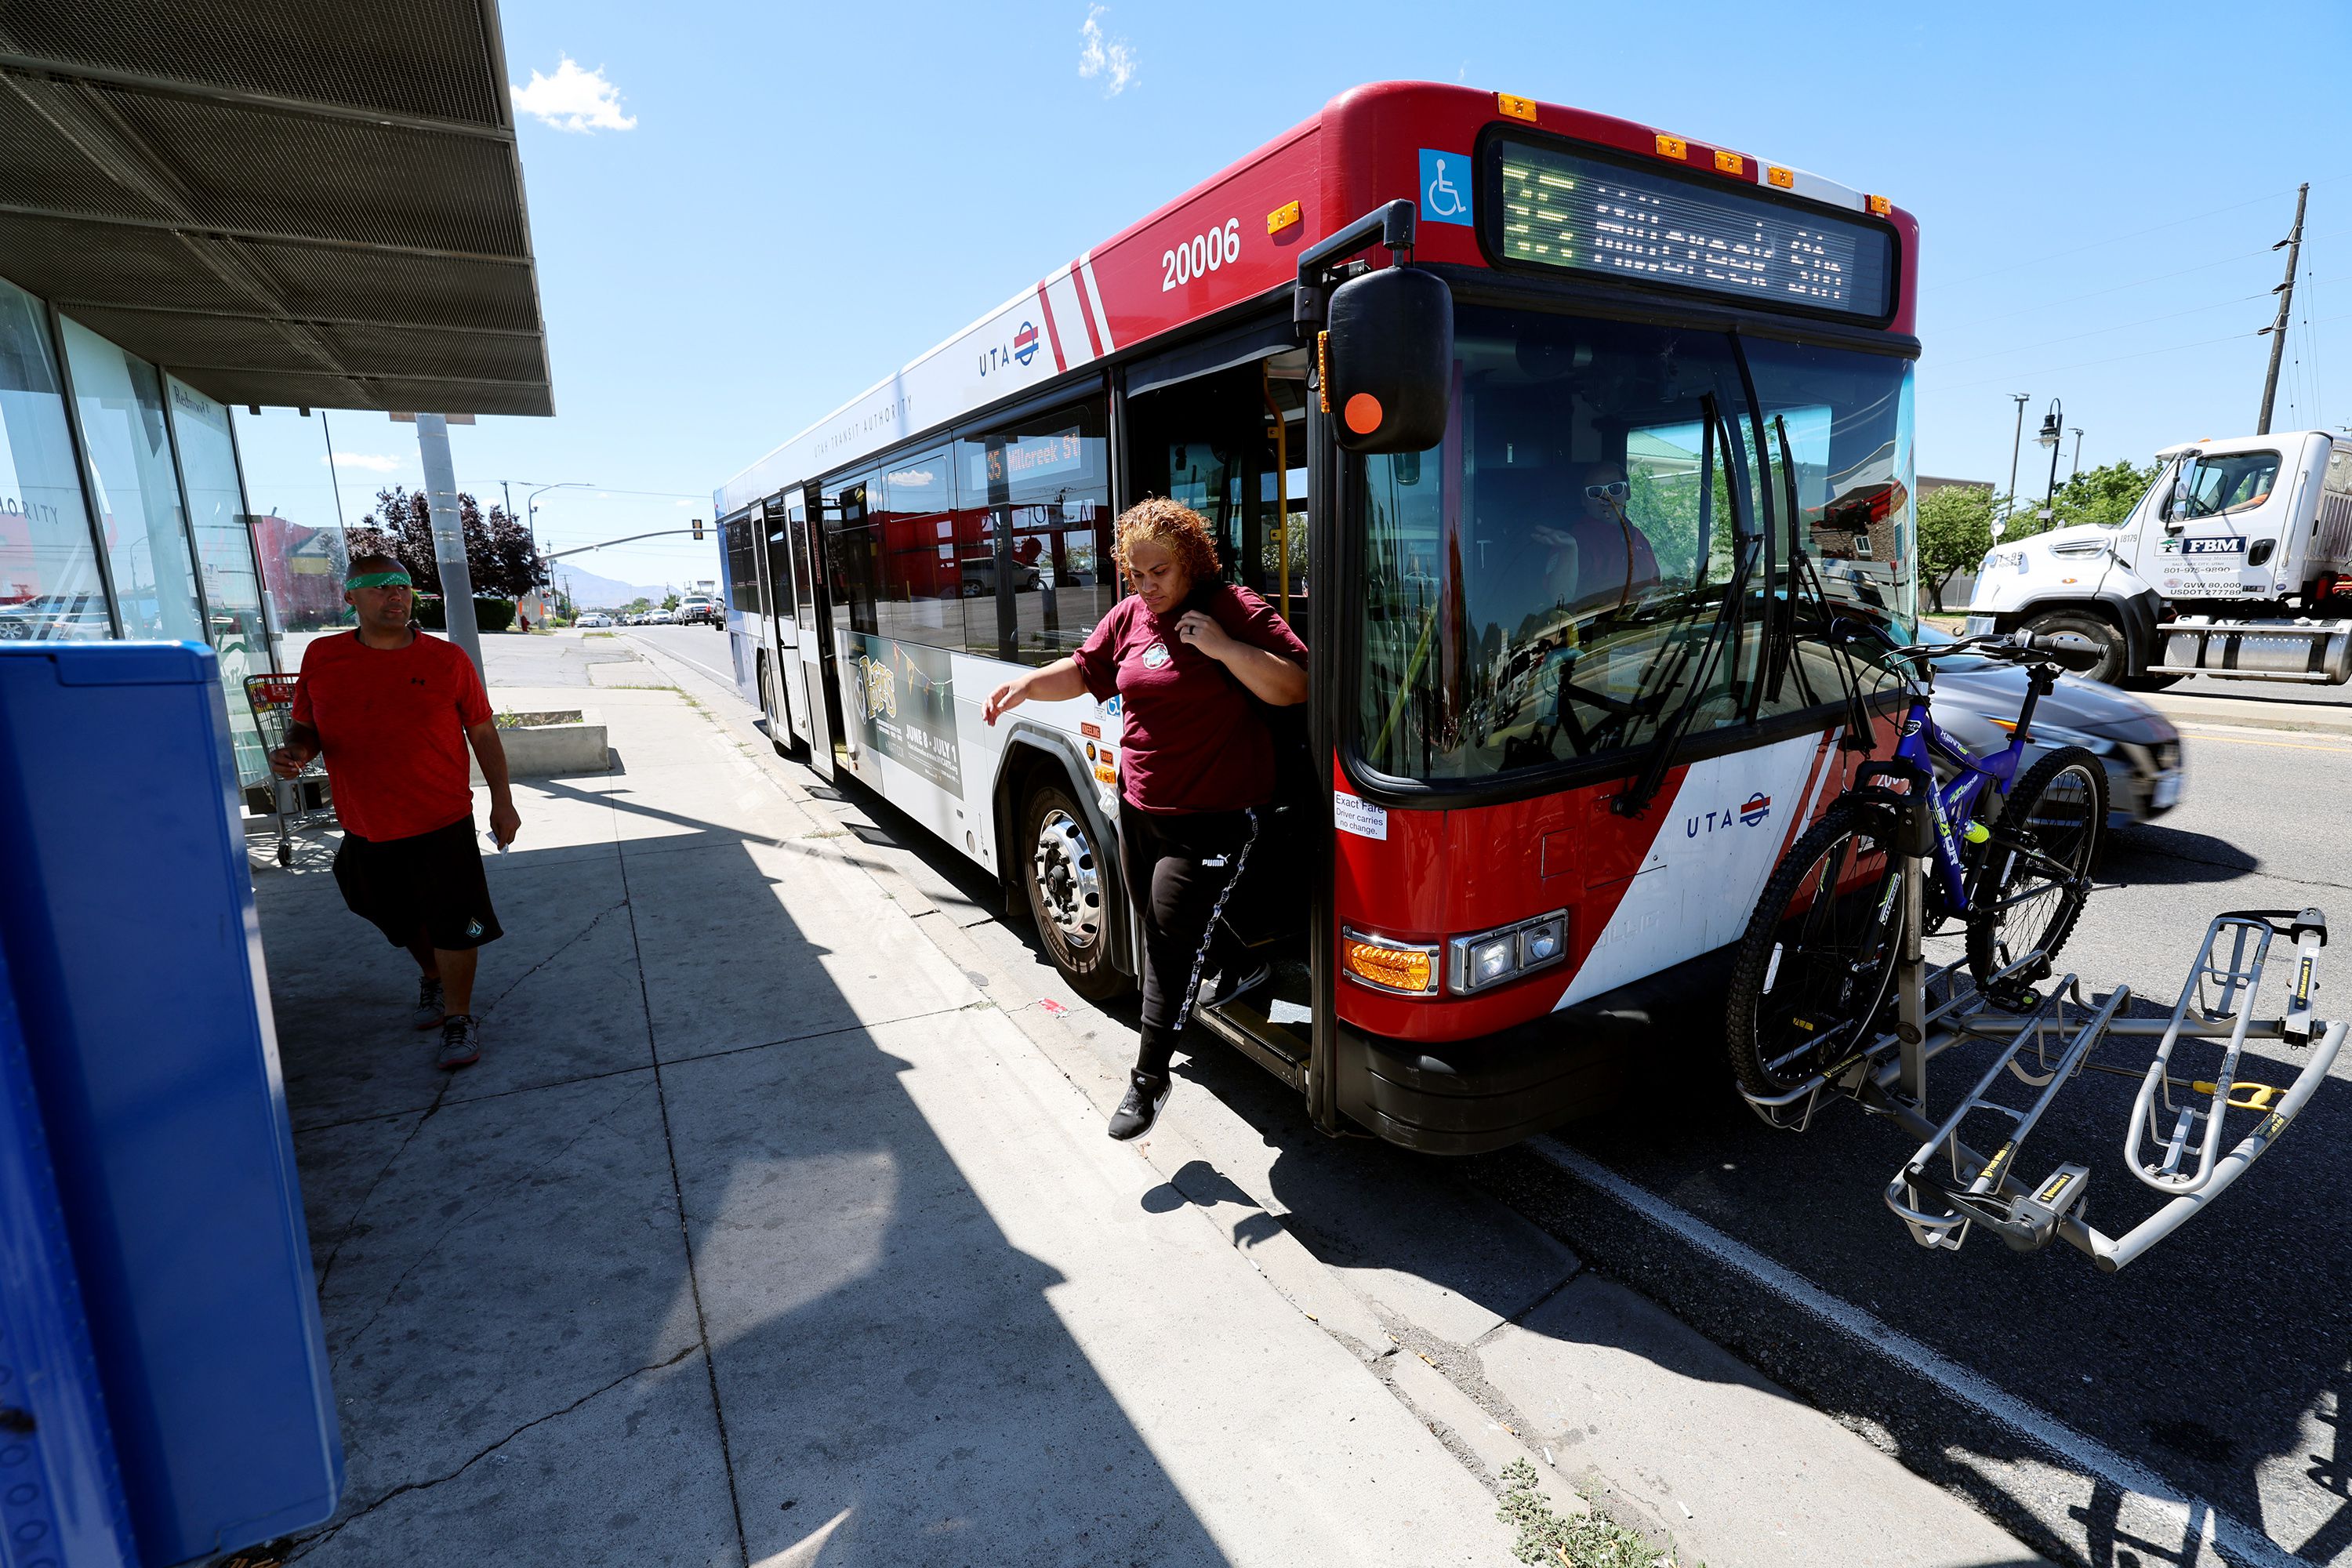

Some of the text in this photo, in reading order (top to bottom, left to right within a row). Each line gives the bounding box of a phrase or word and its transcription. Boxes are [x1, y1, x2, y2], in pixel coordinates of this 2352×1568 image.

[1162, 217, 1240, 292] 20006
[979, 343, 1010, 376] UTA
[814, 394, 912, 458] UTAH TRANSIT AUTHORITY
[988, 450, 1001, 481] 35
[1007, 439, 1058, 471] Millcreek
[2188, 539, 2240, 552] FBM
[1081, 723, 1100, 739] KNEELING
[1940, 729, 1962, 749] KENT
[906, 724, 923, 746] JUNE
[923, 731, 928, 748] 8
[933, 736, 950, 759] JULY
[951, 745, 956, 762] 1
[1101, 750, 1113, 763] RAMP
[1336, 794, 1384, 814] Exact Fare
[1336, 808, 1383, 826] Driver carries
[1687, 808, 1733, 838] UTA
[1349, 822, 1377, 835] change.
